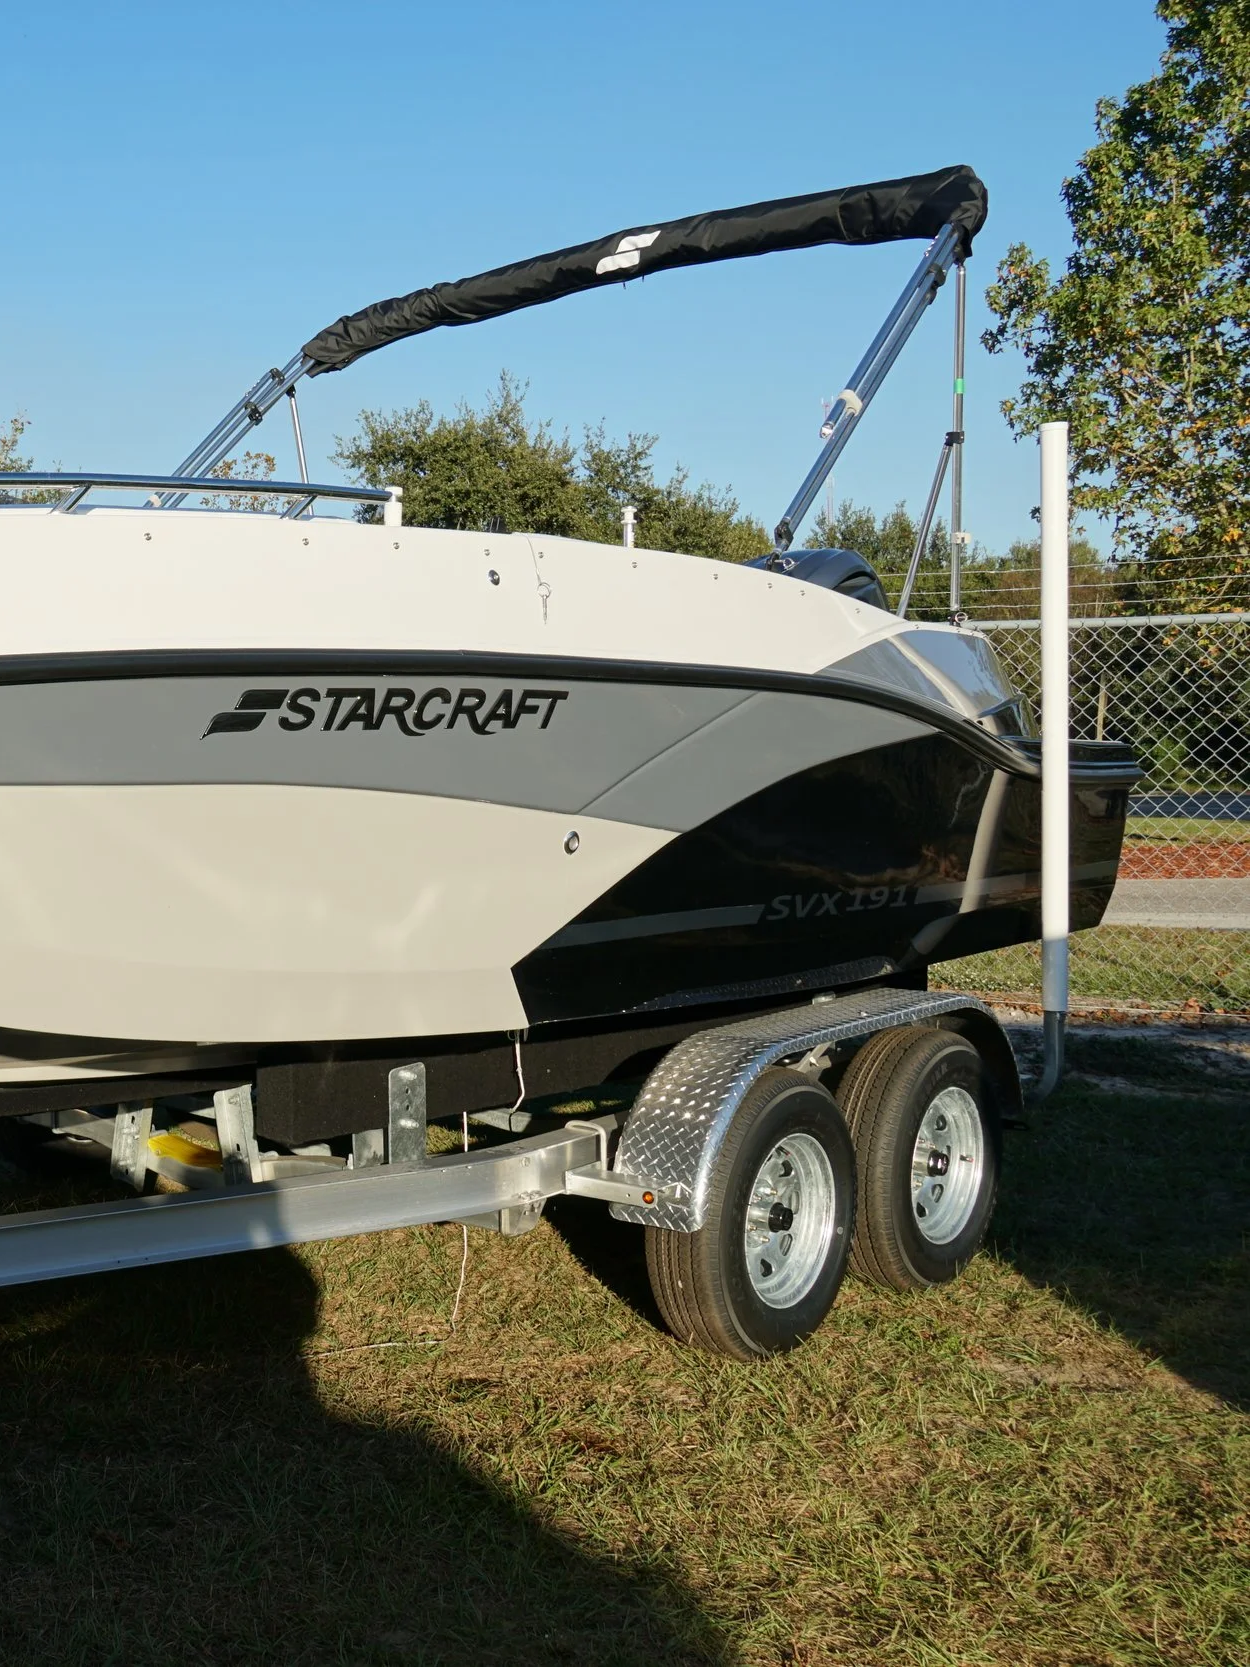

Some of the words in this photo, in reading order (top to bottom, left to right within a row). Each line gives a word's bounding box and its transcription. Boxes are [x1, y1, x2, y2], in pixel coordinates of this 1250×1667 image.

[278, 687, 569, 736] STARCRAFT
[766, 892, 843, 920] SVX
[846, 885, 907, 911] 191
